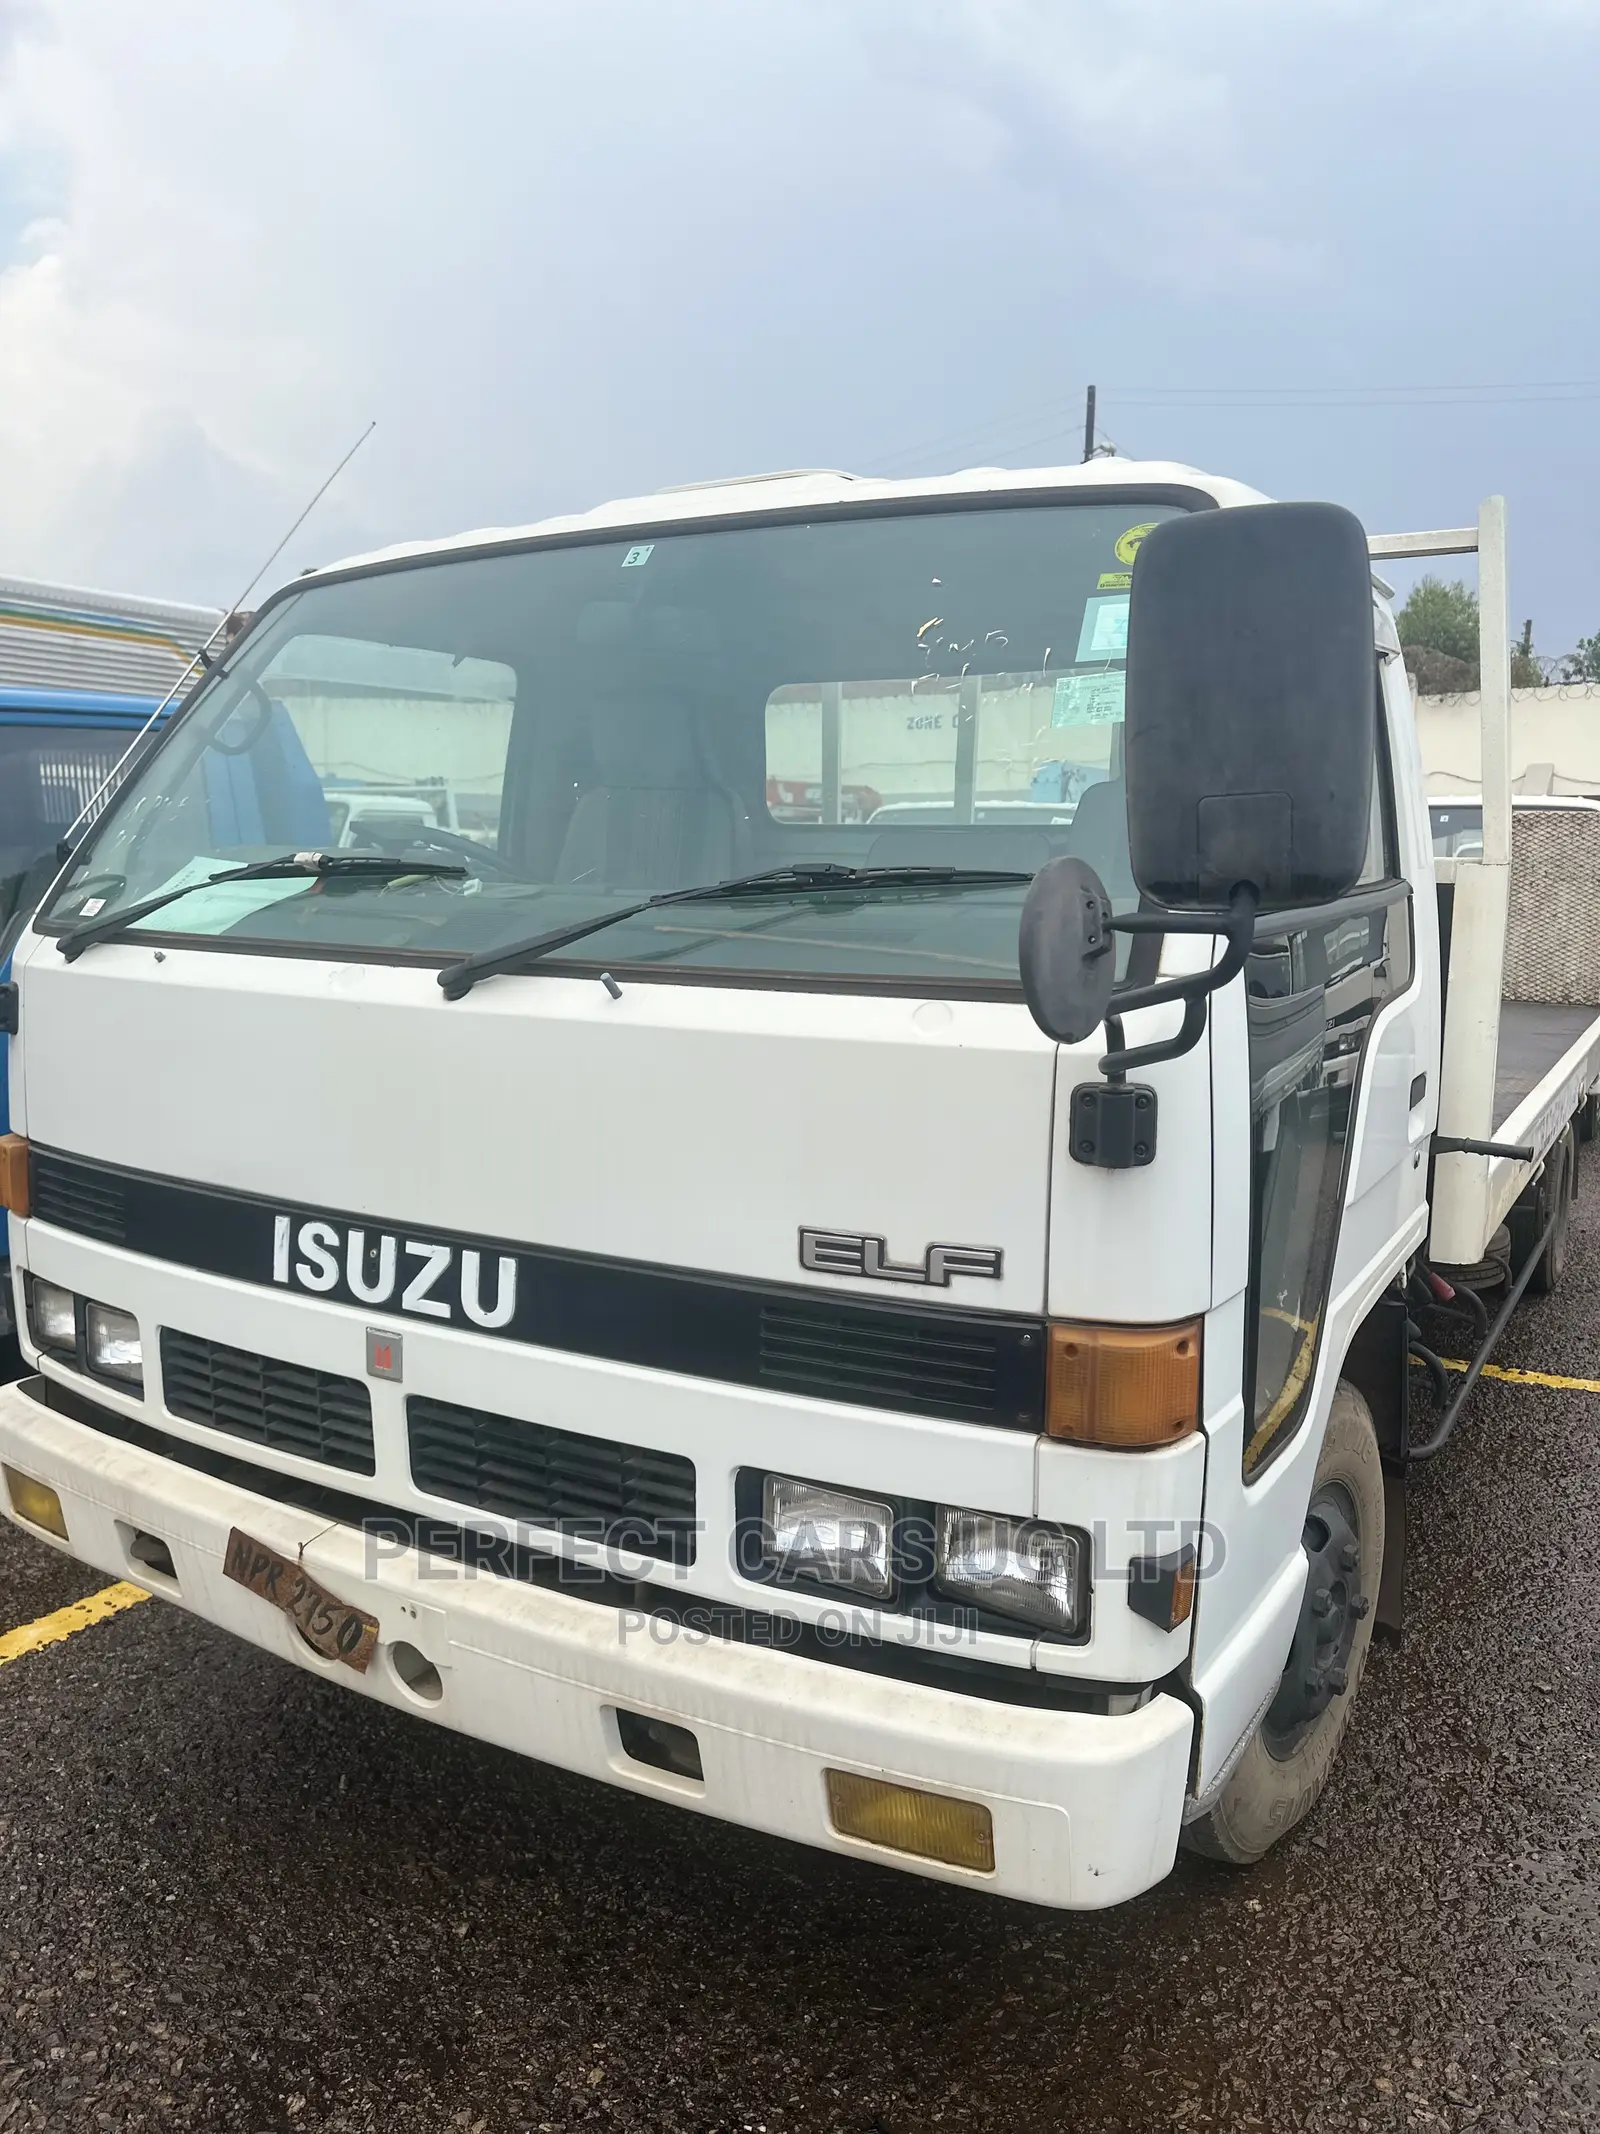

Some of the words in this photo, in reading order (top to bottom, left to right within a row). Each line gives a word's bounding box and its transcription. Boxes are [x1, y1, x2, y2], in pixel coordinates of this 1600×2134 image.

[628, 551, 640, 564] 3
[907, 715, 943, 730] ZONE
[273, 1215, 518, 1328] ISUZU
[799, 1227, 1002, 1287] ELF
[231, 1539, 284, 1600] NPR
